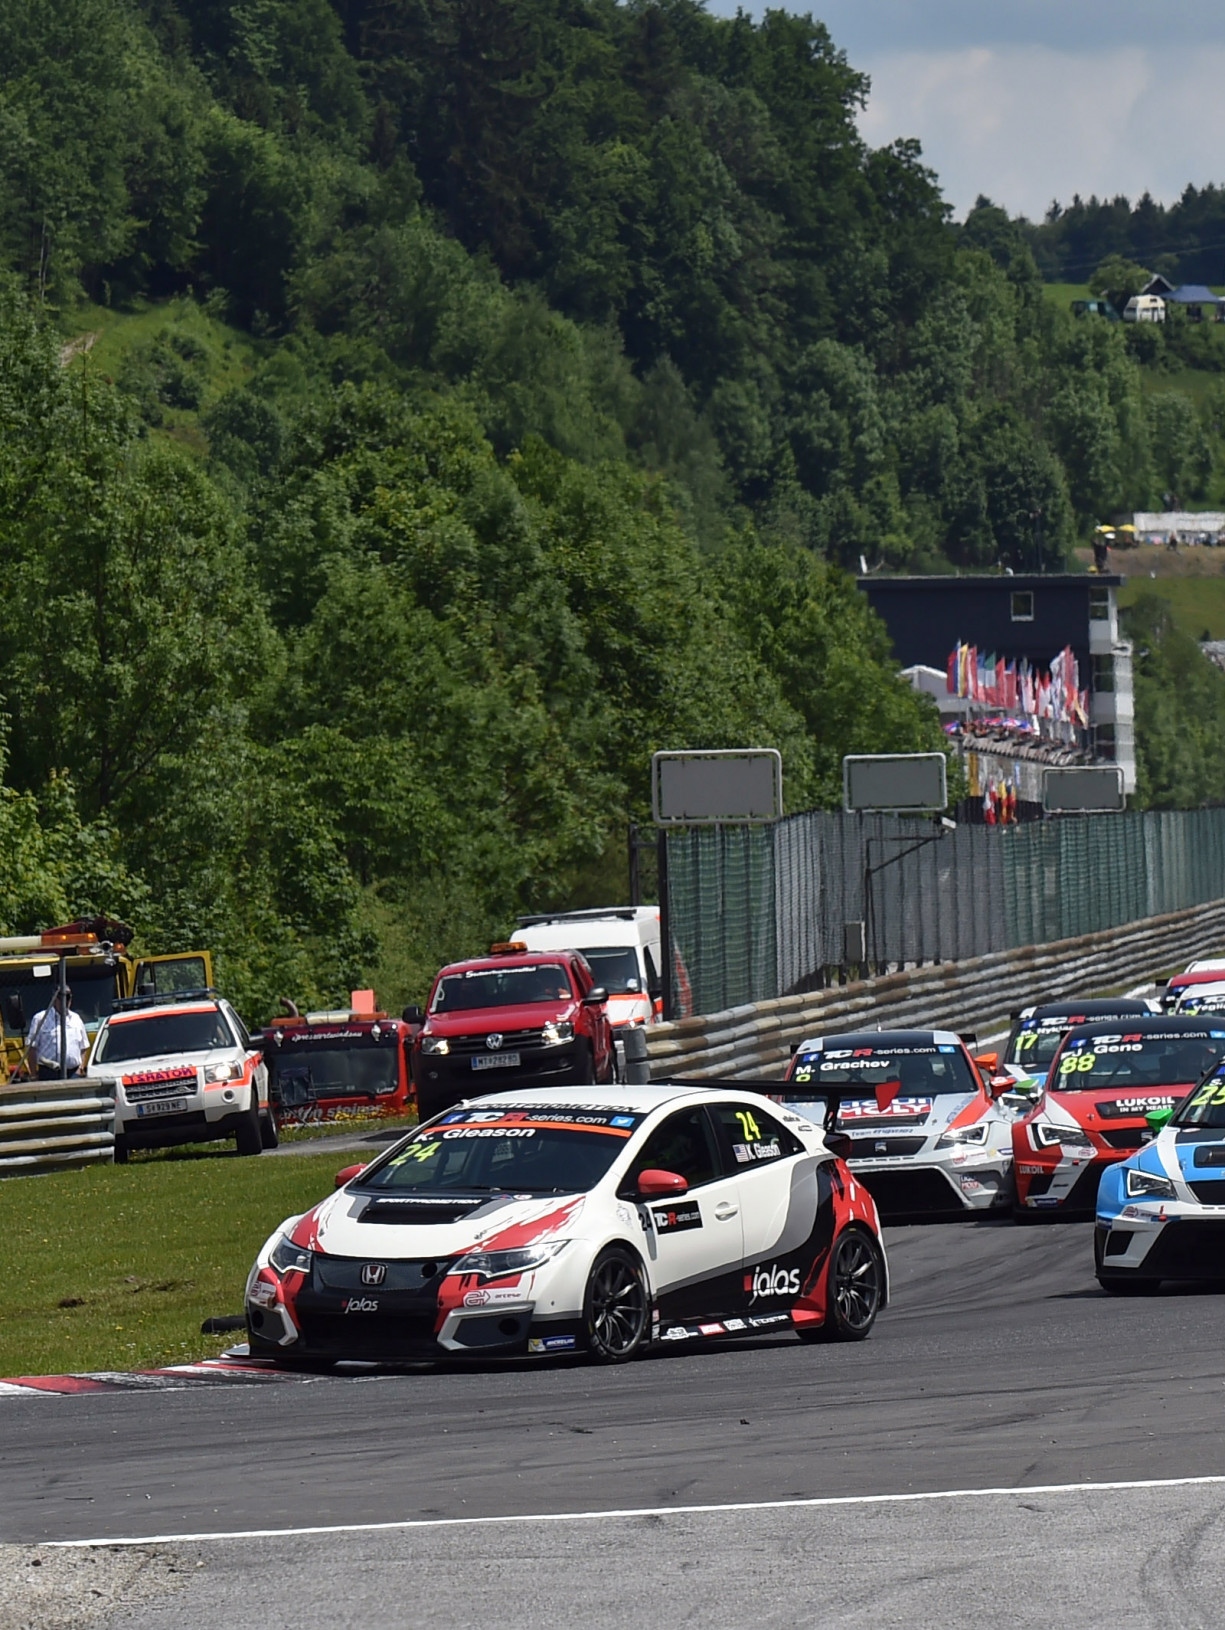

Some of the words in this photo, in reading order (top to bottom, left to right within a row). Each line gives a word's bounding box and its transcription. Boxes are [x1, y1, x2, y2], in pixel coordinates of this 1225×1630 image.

[1015, 1033, 1038, 1051] 17
[1091, 1031, 1208, 1045] TCR-series.com
[823, 1047, 936, 1060] TCR-series.com
[795, 1065, 816, 1075] M.
[820, 1060, 890, 1071] Grachov
[1059, 1054, 1096, 1074] 88
[1116, 1096, 1175, 1107] LUKOIL
[465, 1111, 607, 1125] TCR-series.com
[735, 1111, 762, 1141] 24
[414, 1131, 435, 1144] K.
[443, 1127, 536, 1140] Gleason
[388, 1141, 442, 1166] 24
[748, 1263, 801, 1307] jalas
[344, 1296, 380, 1314] jalas
